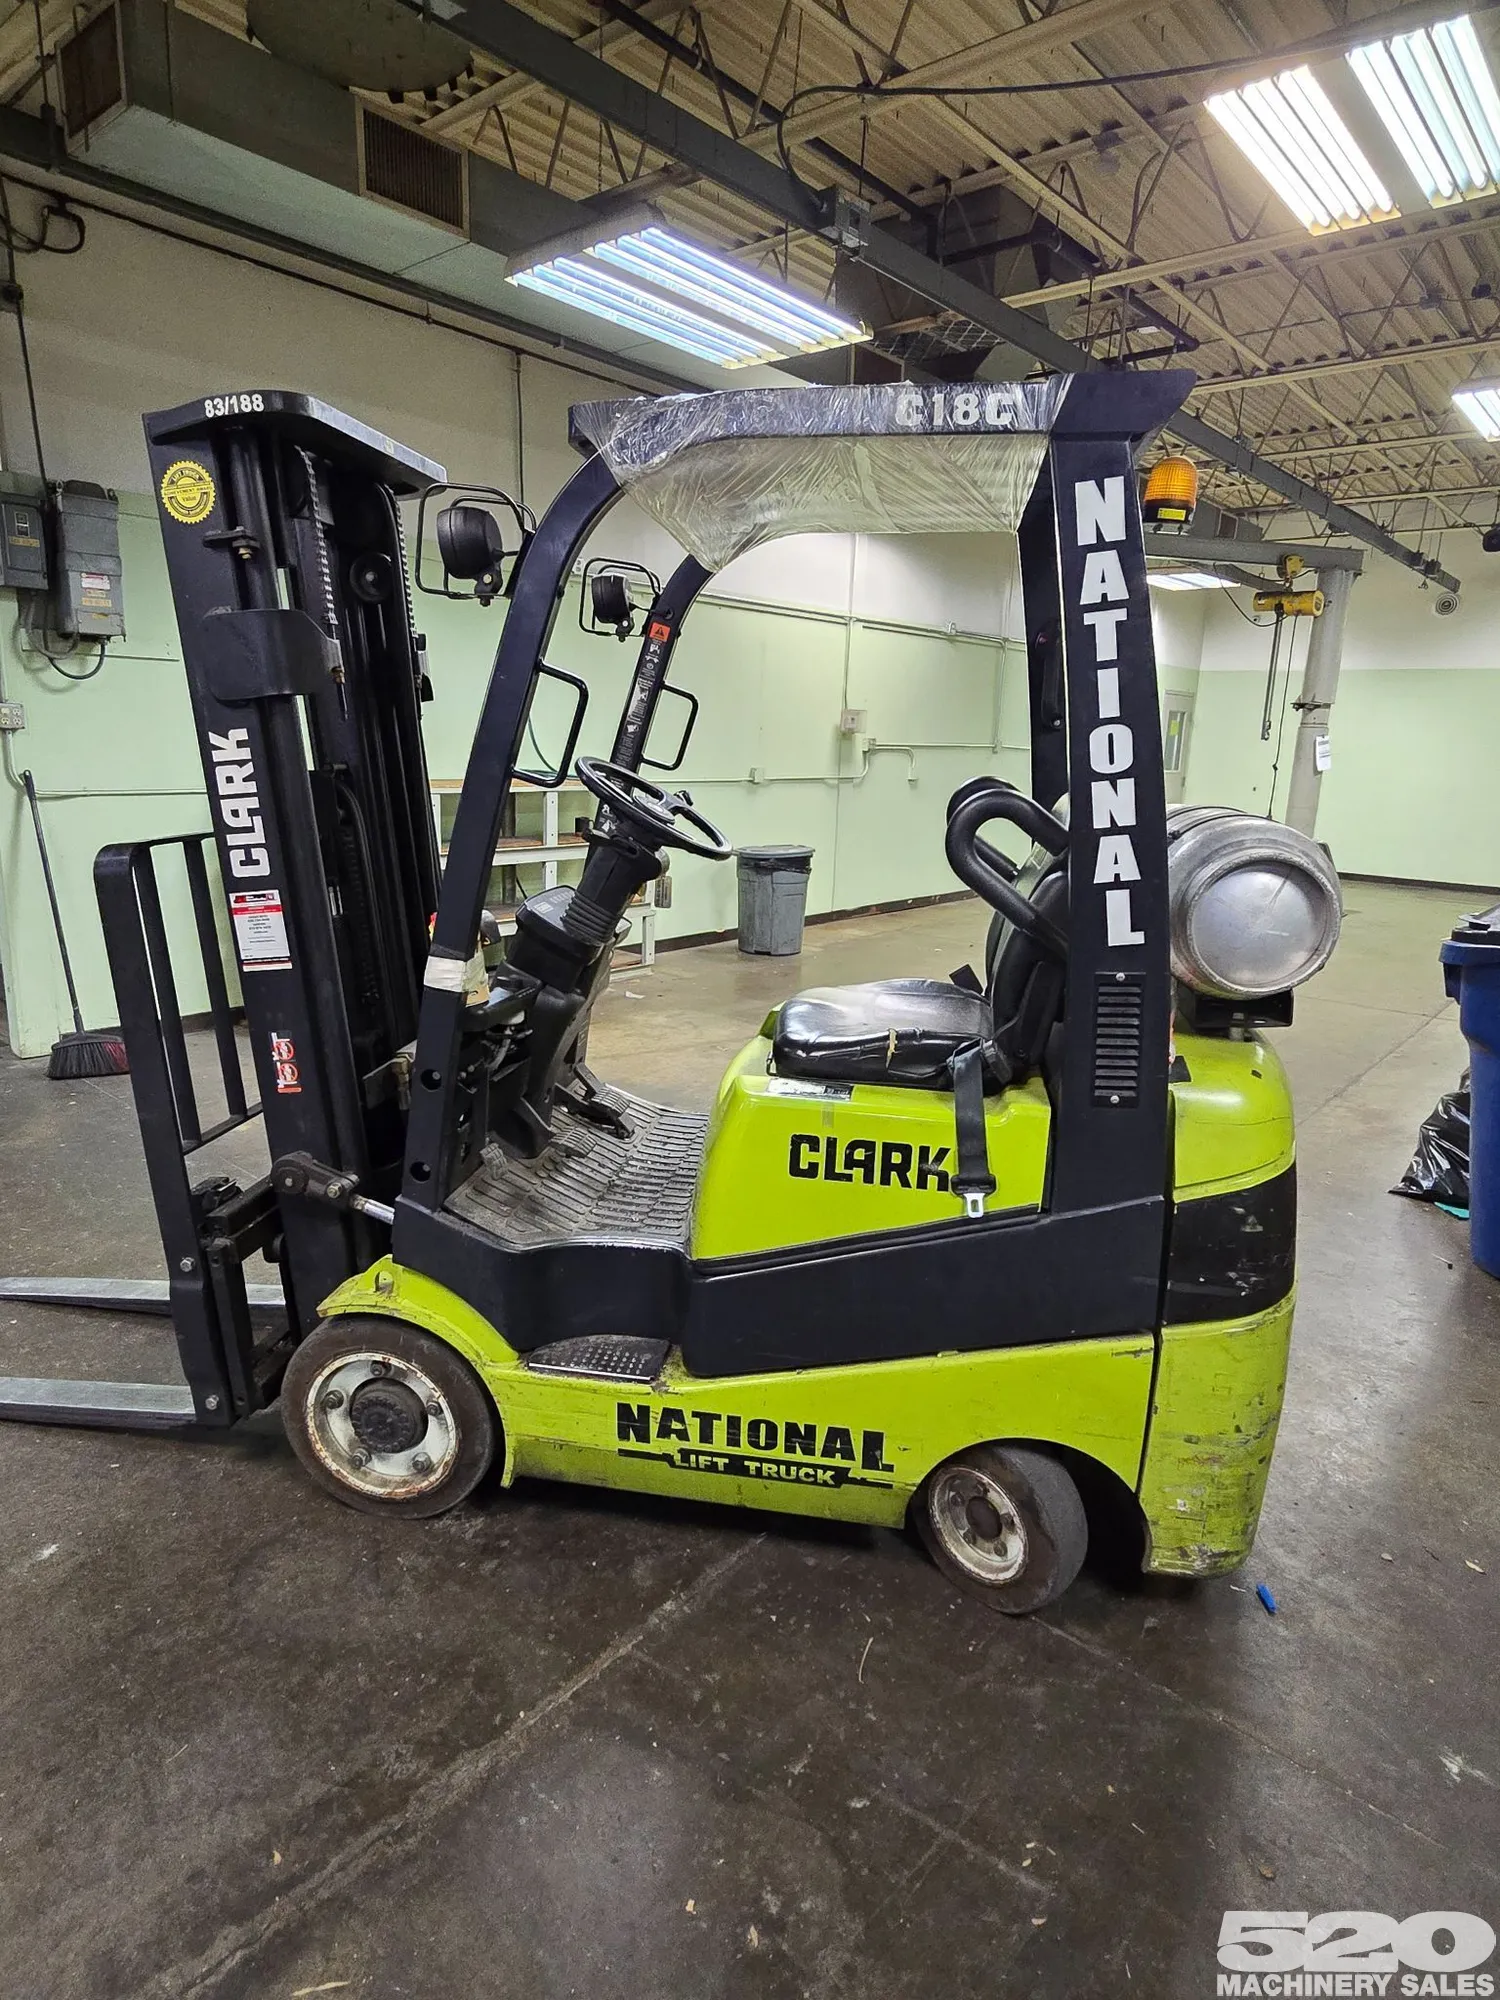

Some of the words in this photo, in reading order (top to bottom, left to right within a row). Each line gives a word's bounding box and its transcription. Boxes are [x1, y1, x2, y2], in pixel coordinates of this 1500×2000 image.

[204, 393, 265, 418] 83/188
[895, 392, 1014, 426] C18C
[1074, 476, 1145, 948] NATIONAL
[208, 728, 271, 879] CLARK
[789, 1133, 952, 1193] CLARK
[616, 1402, 895, 1473] NATIONAL
[674, 1452, 728, 1473] LIFT
[745, 1460, 836, 1486] TRUCK
